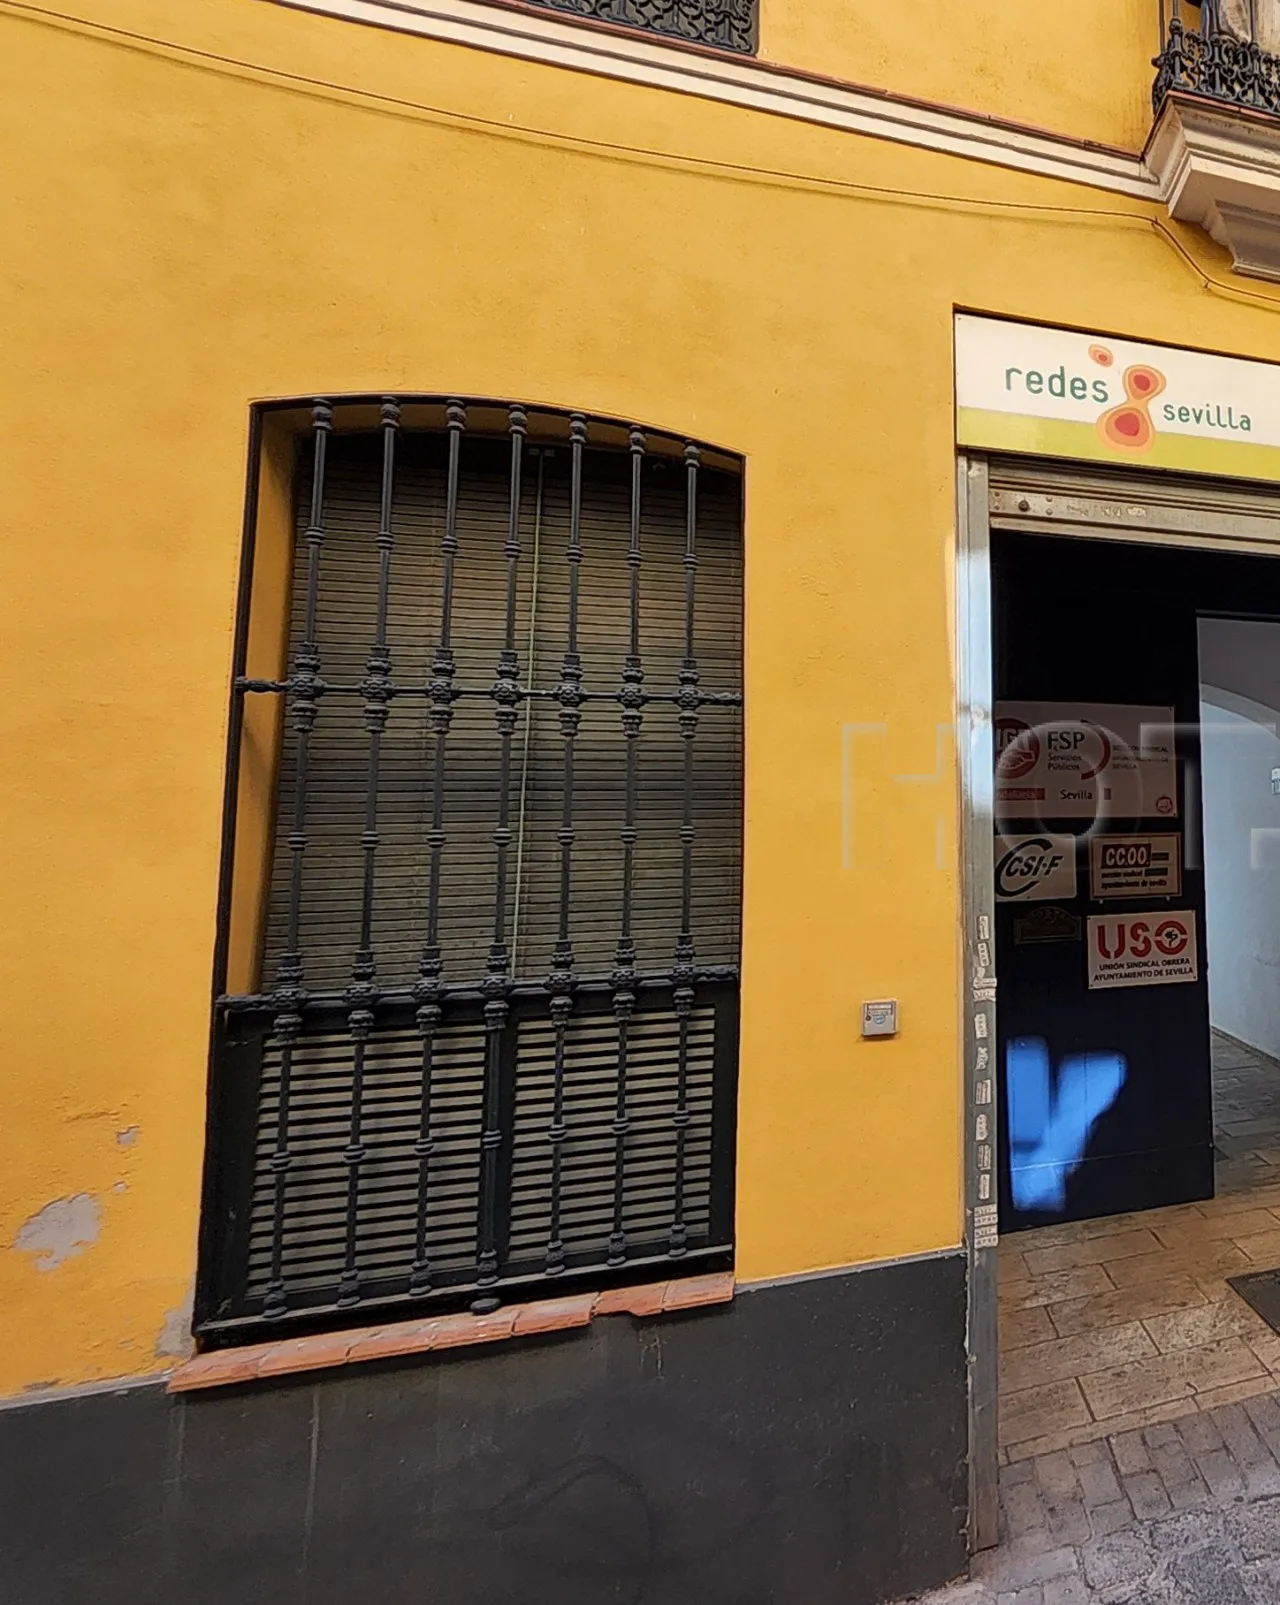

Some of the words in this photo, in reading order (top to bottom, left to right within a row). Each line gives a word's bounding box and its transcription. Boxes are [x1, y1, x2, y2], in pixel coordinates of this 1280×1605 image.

[1004, 366, 1109, 403] redes
[1163, 403, 1251, 431] sevilla
[1047, 731, 1085, 750] FSP
[1048, 752, 1082, 761] Servicios
[1060, 789, 1093, 800] Sevilla
[1097, 920, 1188, 960] USO
[1099, 962, 1124, 971] UNIÓN
[1126, 960, 1160, 969] SINDICAL
[1161, 958, 1190, 967] OBRERA
[1093, 970, 1152, 981] AYUNTAMIENTO
[1154, 969, 1164, 977] DE
[1165, 967, 1194, 976] SEVILLA
